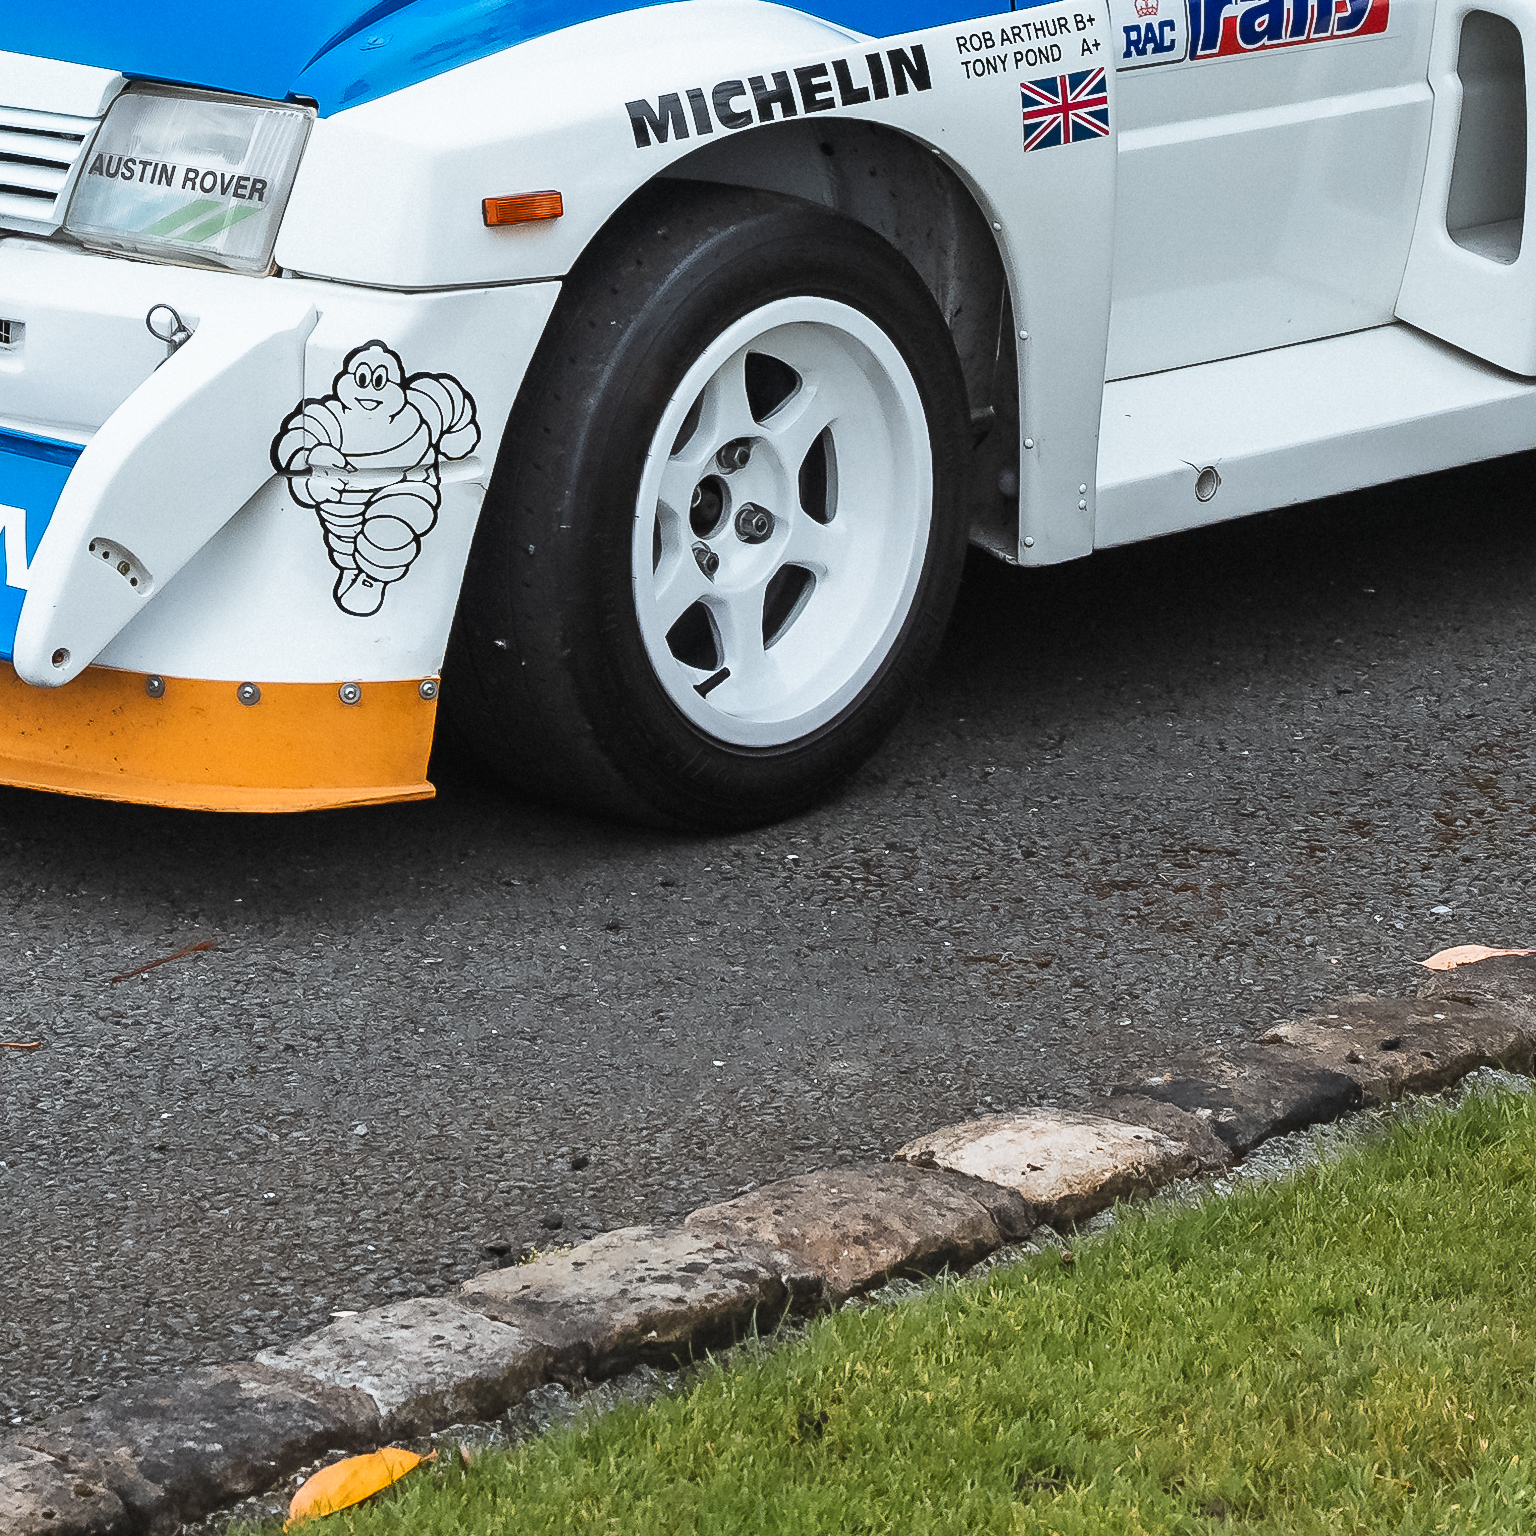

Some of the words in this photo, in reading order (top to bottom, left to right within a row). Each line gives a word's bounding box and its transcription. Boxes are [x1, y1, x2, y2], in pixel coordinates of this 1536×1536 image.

[956, 30, 996, 54] ROB
[1000, 17, 1071, 46] ARTHUR
[1073, 13, 1097, 32] B+
[1122, 18, 1176, 59] RAC
[960, 53, 1009, 79] TONY
[1014, 43, 1062, 70] POND
[1080, 37, 1101, 57] A+
[625, 44, 933, 149] MICHELIN
[88, 153, 175, 187] AUSTIN
[181, 167, 268, 202] ROVER
